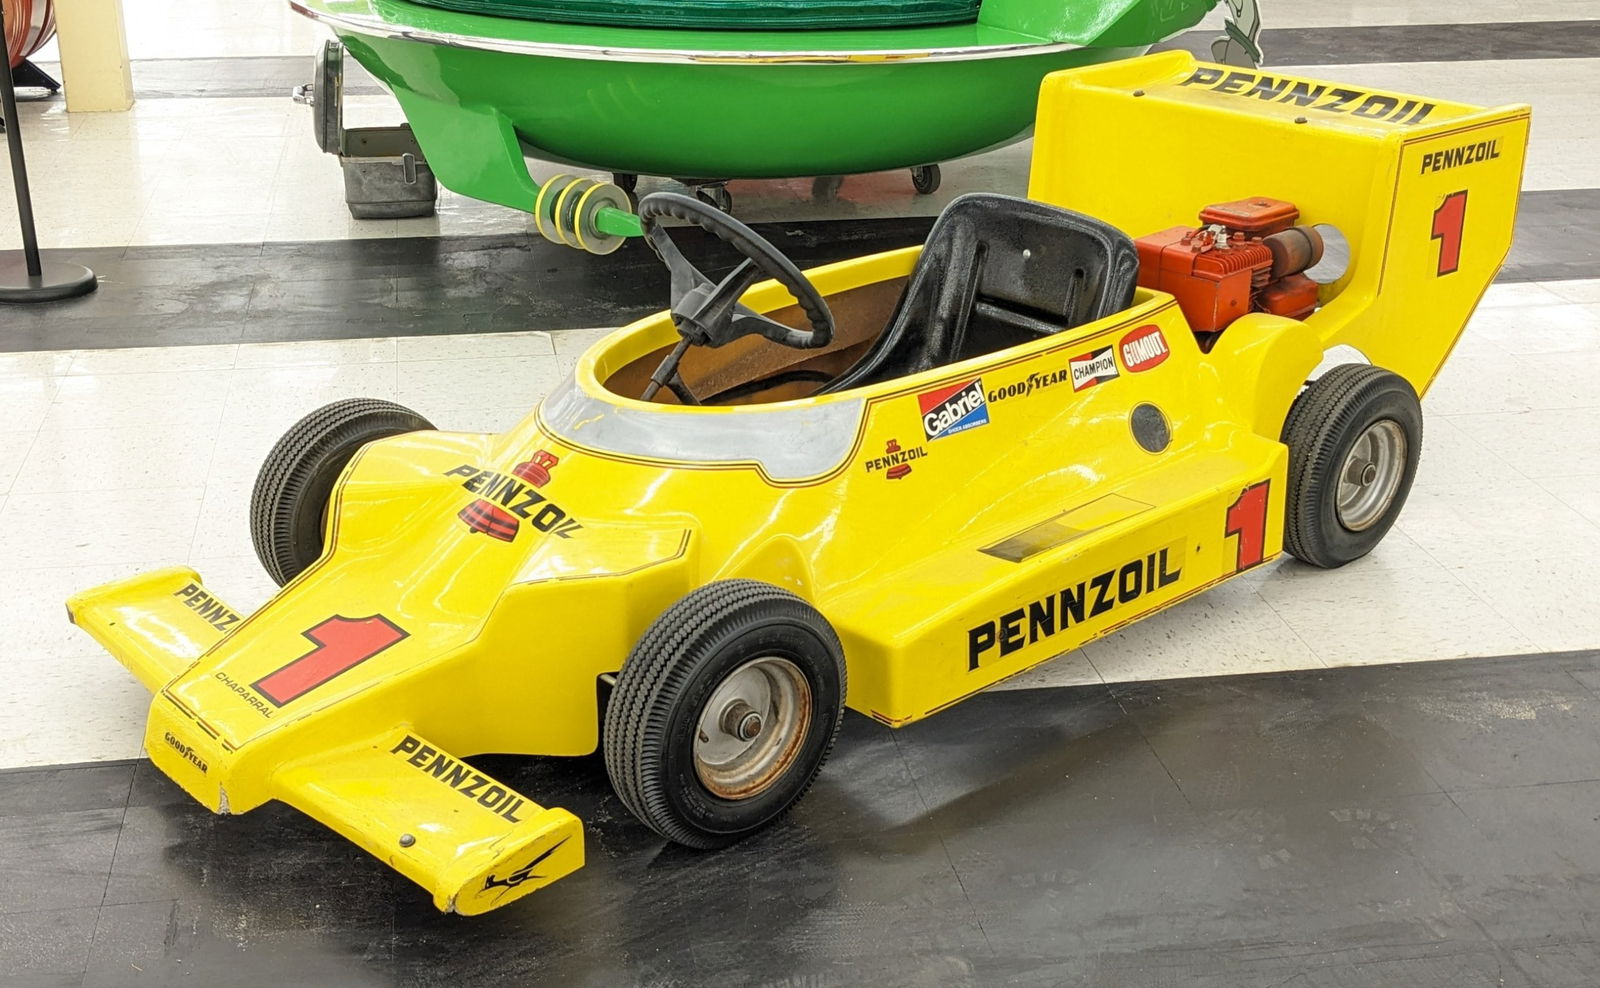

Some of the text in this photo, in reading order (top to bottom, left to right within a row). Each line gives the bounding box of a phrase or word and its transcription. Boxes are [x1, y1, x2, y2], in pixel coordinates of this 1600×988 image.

[1181, 67, 1436, 125] PENNZOIL
[1420, 139, 1500, 175] PENNZOIL
[1430, 189, 1468, 277] 1
[1073, 356, 1114, 380] CHAMPION
[1122, 331, 1167, 367] GUMOUT
[924, 381, 985, 436] Gabriel
[988, 369, 1068, 403] GOODYEAR
[865, 446, 928, 473] PENNZOIL
[443, 464, 584, 539] PENNZOIL
[1224, 478, 1271, 573] 1
[173, 583, 241, 635] PENNZ
[967, 547, 1183, 673] PENNZOIL
[250, 613, 412, 709] 1
[215, 671, 274, 719] CHAPARRAL
[164, 731, 208, 775] GOODYEAR
[390, 734, 525, 824] PENNZOIL
